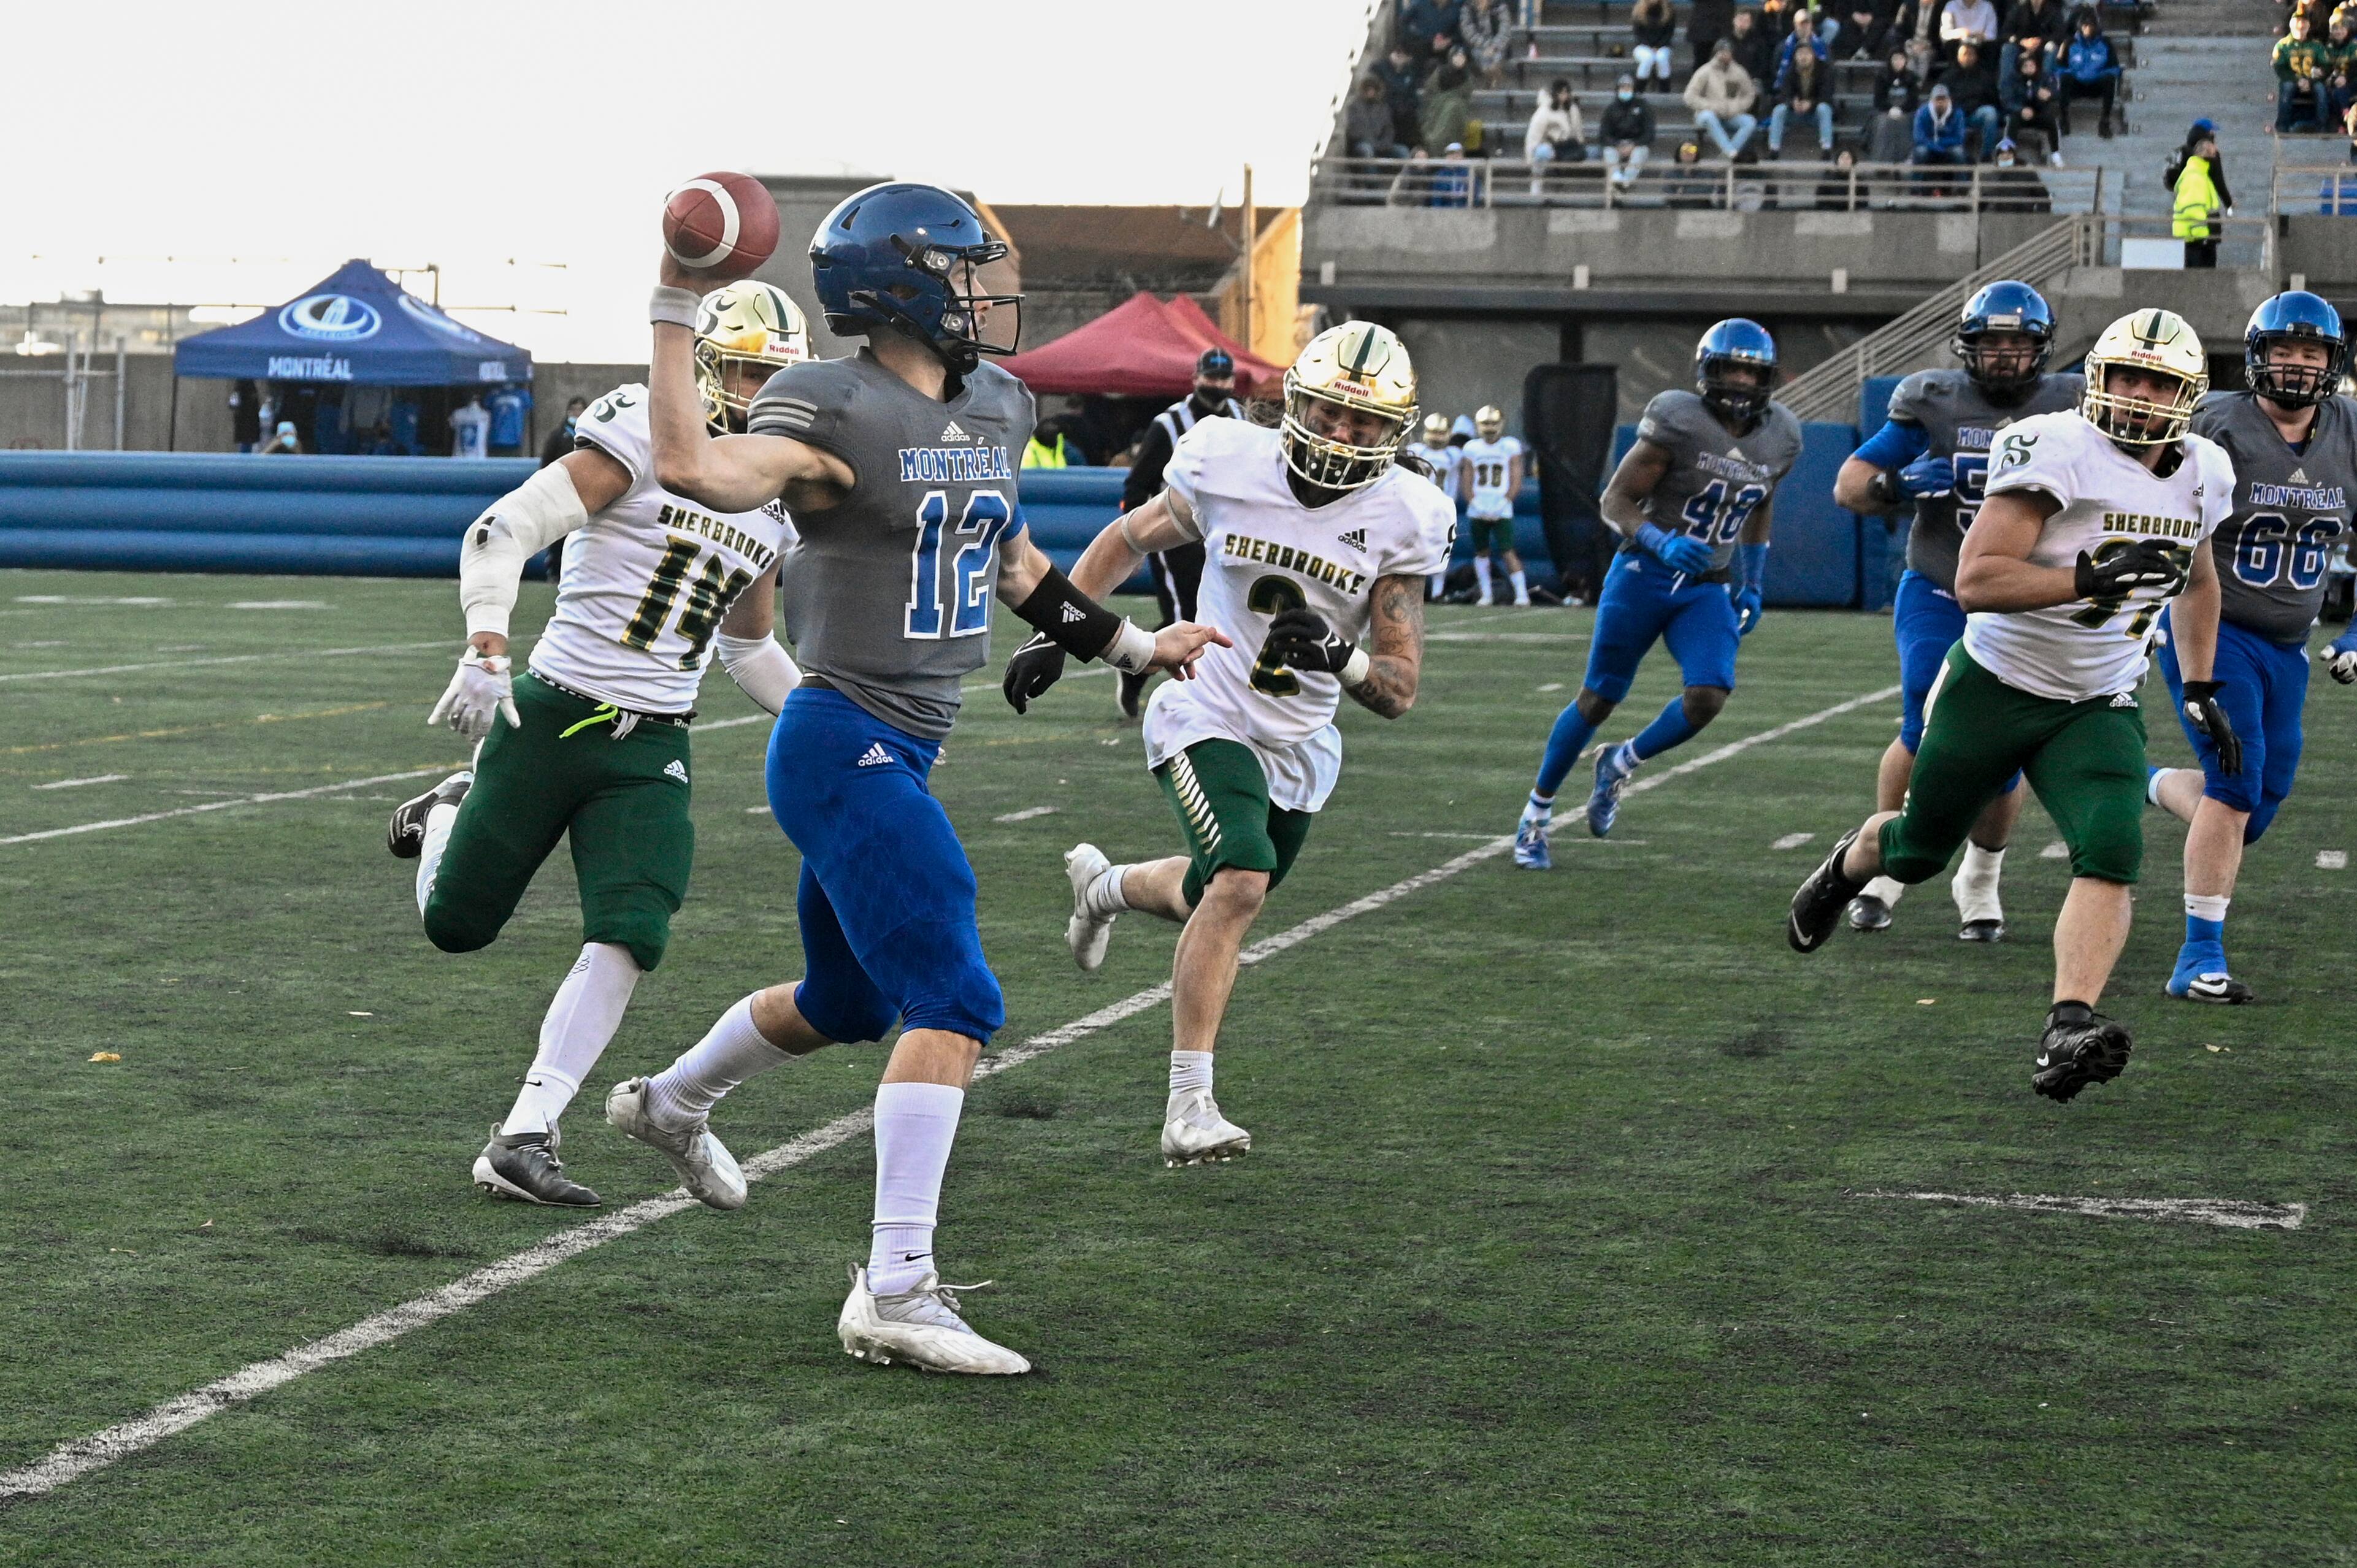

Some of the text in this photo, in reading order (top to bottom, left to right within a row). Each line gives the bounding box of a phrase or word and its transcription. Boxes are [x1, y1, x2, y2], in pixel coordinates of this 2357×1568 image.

[768, 344, 800, 355] Riddell
[2131, 350, 2163, 362] Riddell
[268, 351, 354, 381] MONTRÉAL
[1333, 381, 1370, 398] Riddell
[898, 437, 1012, 483] MONTRÉAL
[2249, 481, 2347, 511] MONTRÉAL
[761, 506, 786, 526] adidas
[1681, 478, 1768, 545] 48
[657, 503, 775, 570] SHERBROOKE
[1337, 534, 1368, 554] adidas
[2232, 511, 2344, 591] 66
[904, 490, 1011, 639] 12
[1224, 532, 1367, 596] SHERBROOKE
[1063, 600, 1087, 619] adidas
[857, 755, 894, 767] adidas
[664, 767, 689, 784] adidas
